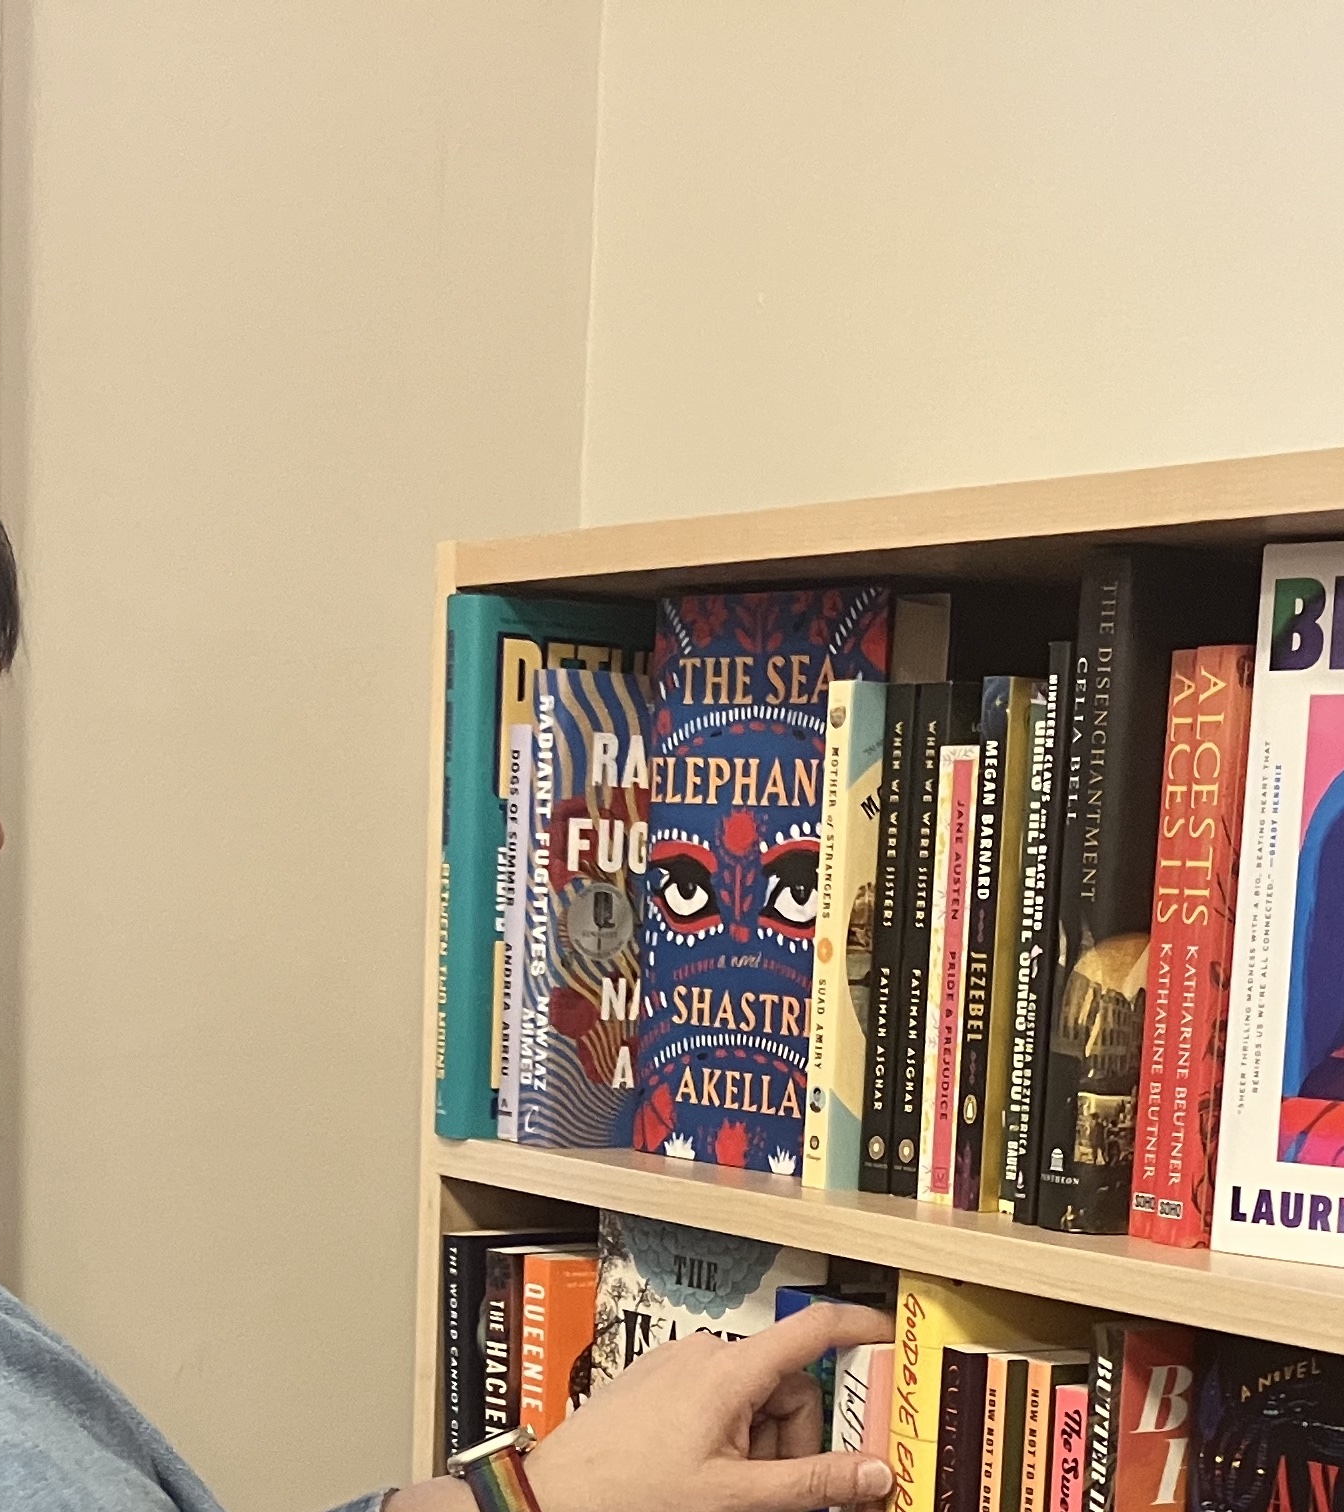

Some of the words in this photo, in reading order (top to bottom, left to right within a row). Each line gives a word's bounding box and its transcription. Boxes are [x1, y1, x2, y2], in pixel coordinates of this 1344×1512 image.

[679, 656, 754, 705] THE
[765, 654, 836, 705] SEA
[1071, 657, 1088, 743] CELIA
[509, 749, 521, 798] DOGS
[535, 695, 555, 819] RADIANT
[982, 740, 999, 806] MEGAN
[1066, 756, 1081, 824] BELL
[508, 803, 519, 827] OF
[953, 800, 965, 845] JANE
[1156, 671, 1196, 923] ALCESTIS
[1182, 665, 1228, 927] ALCESTIS
[506, 831, 518, 907] SUMMER
[949, 851, 964, 920] AUSTEN
[976, 813, 996, 901] BARNARD
[530, 832, 551, 977] FUGITIVES
[816, 978, 827, 1016] SUAD
[966, 951, 988, 1043] JEZEBEL
[813, 1022, 825, 1070] AMIRY
[675, 1065, 802, 1119] AKELLA
[674, 1254, 718, 1292] THE
[522, 1282, 545, 1413] QUEENIE
[897, 1293, 926, 1439] GOODBYE
[1240, 1384, 1251, 1402] A
[1258, 1357, 1321, 1393] NOVEL
